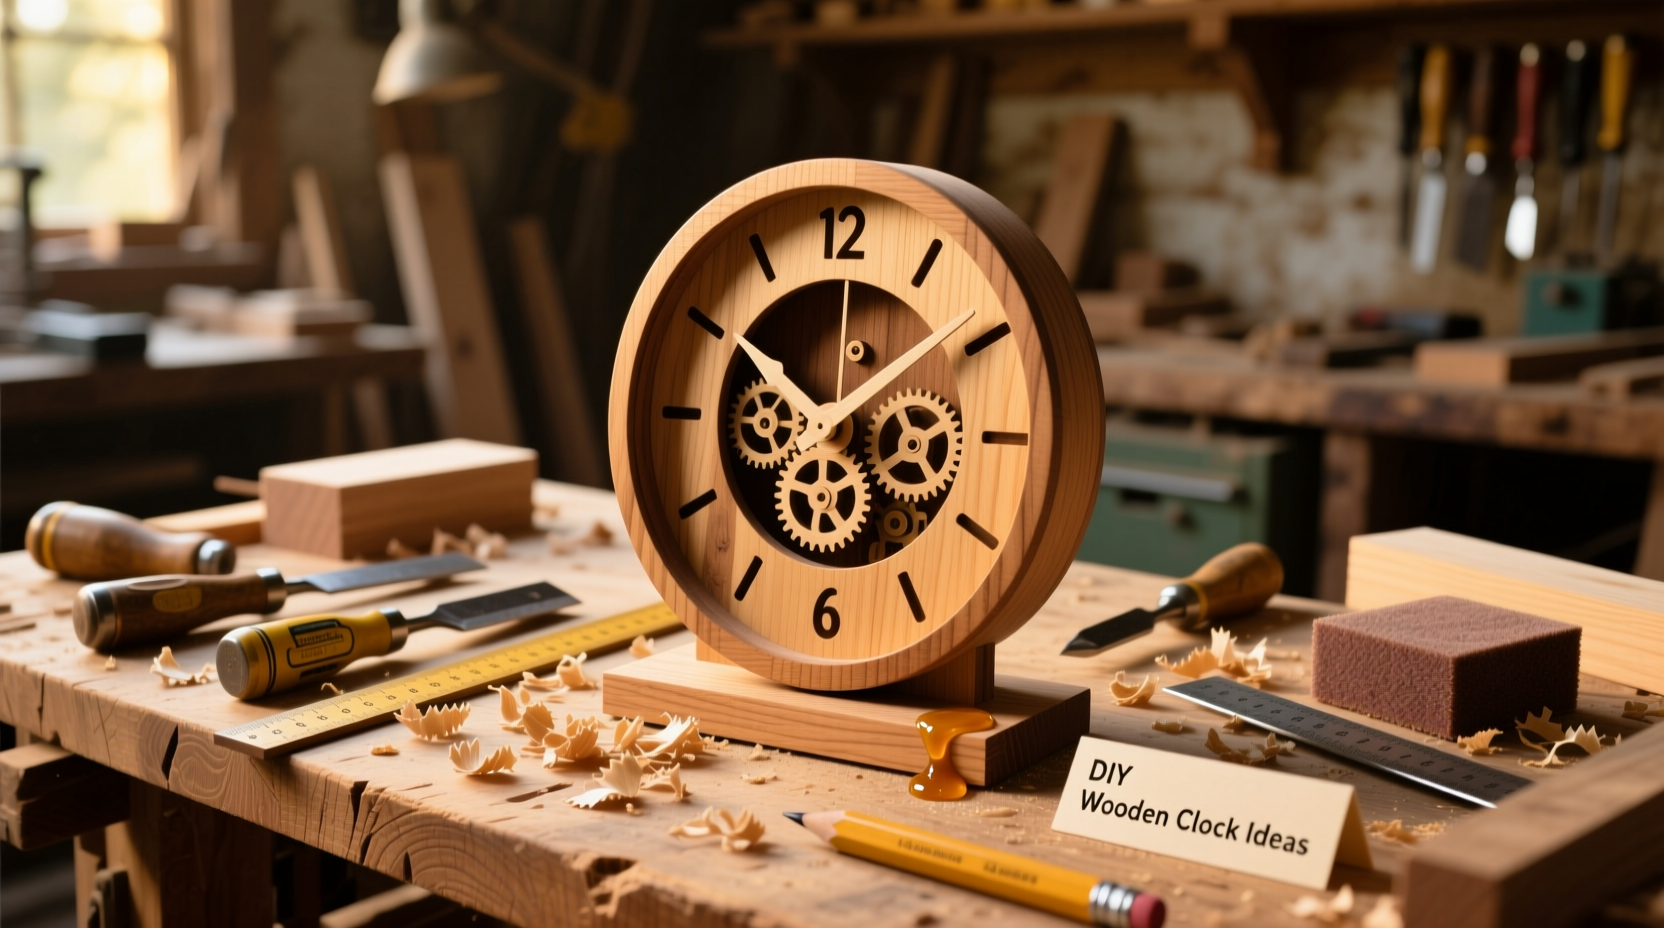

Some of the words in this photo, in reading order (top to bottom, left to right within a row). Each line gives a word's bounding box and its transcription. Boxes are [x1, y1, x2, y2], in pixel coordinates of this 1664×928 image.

[819, 205, 866, 260] 12
[812, 587, 841, 640] 6
[1088, 758, 1134, 786] DIY
[1080, 788, 1170, 827] Wooden
[1176, 808, 1240, 841] Clock
[1246, 821, 1310, 856] Ideas
